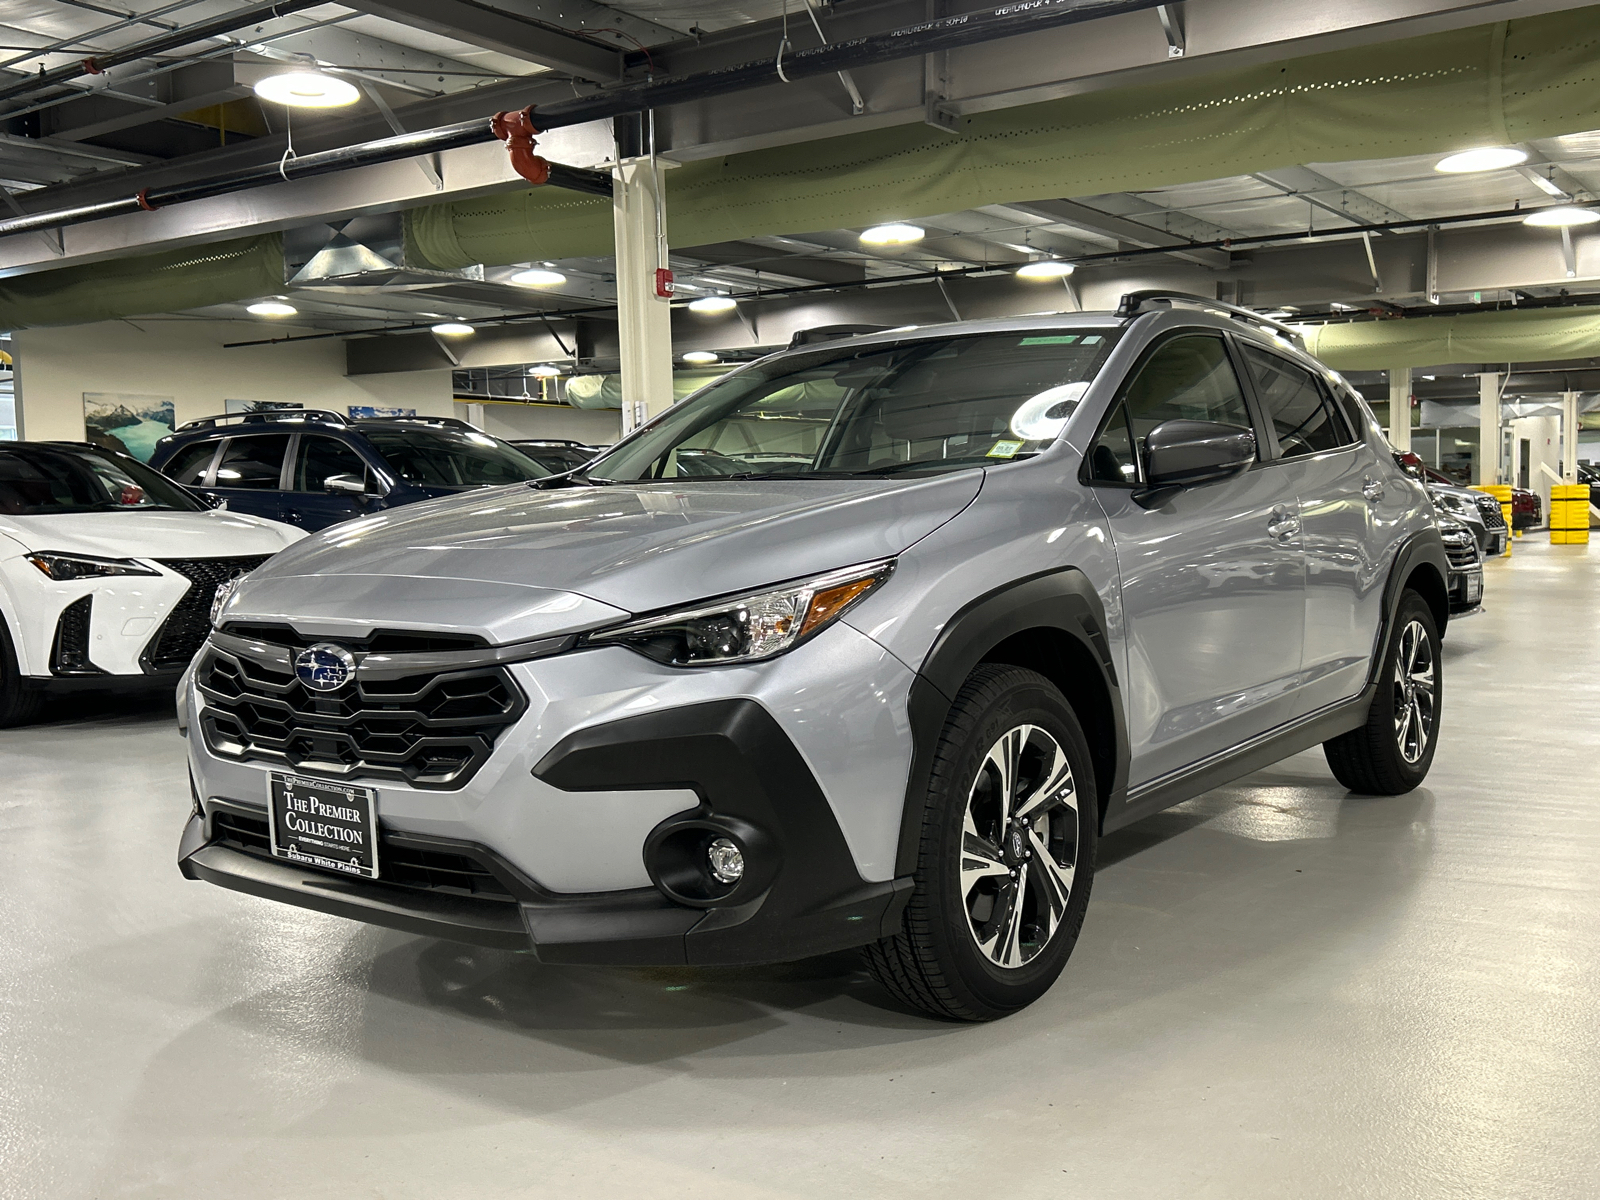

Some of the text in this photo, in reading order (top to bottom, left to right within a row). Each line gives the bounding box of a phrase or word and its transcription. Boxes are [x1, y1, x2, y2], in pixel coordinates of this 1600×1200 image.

[283, 791, 362, 823] THE PREMIER
[285, 811, 363, 845] COLLECTION
[287, 851, 361, 874] Subaru White Plains
